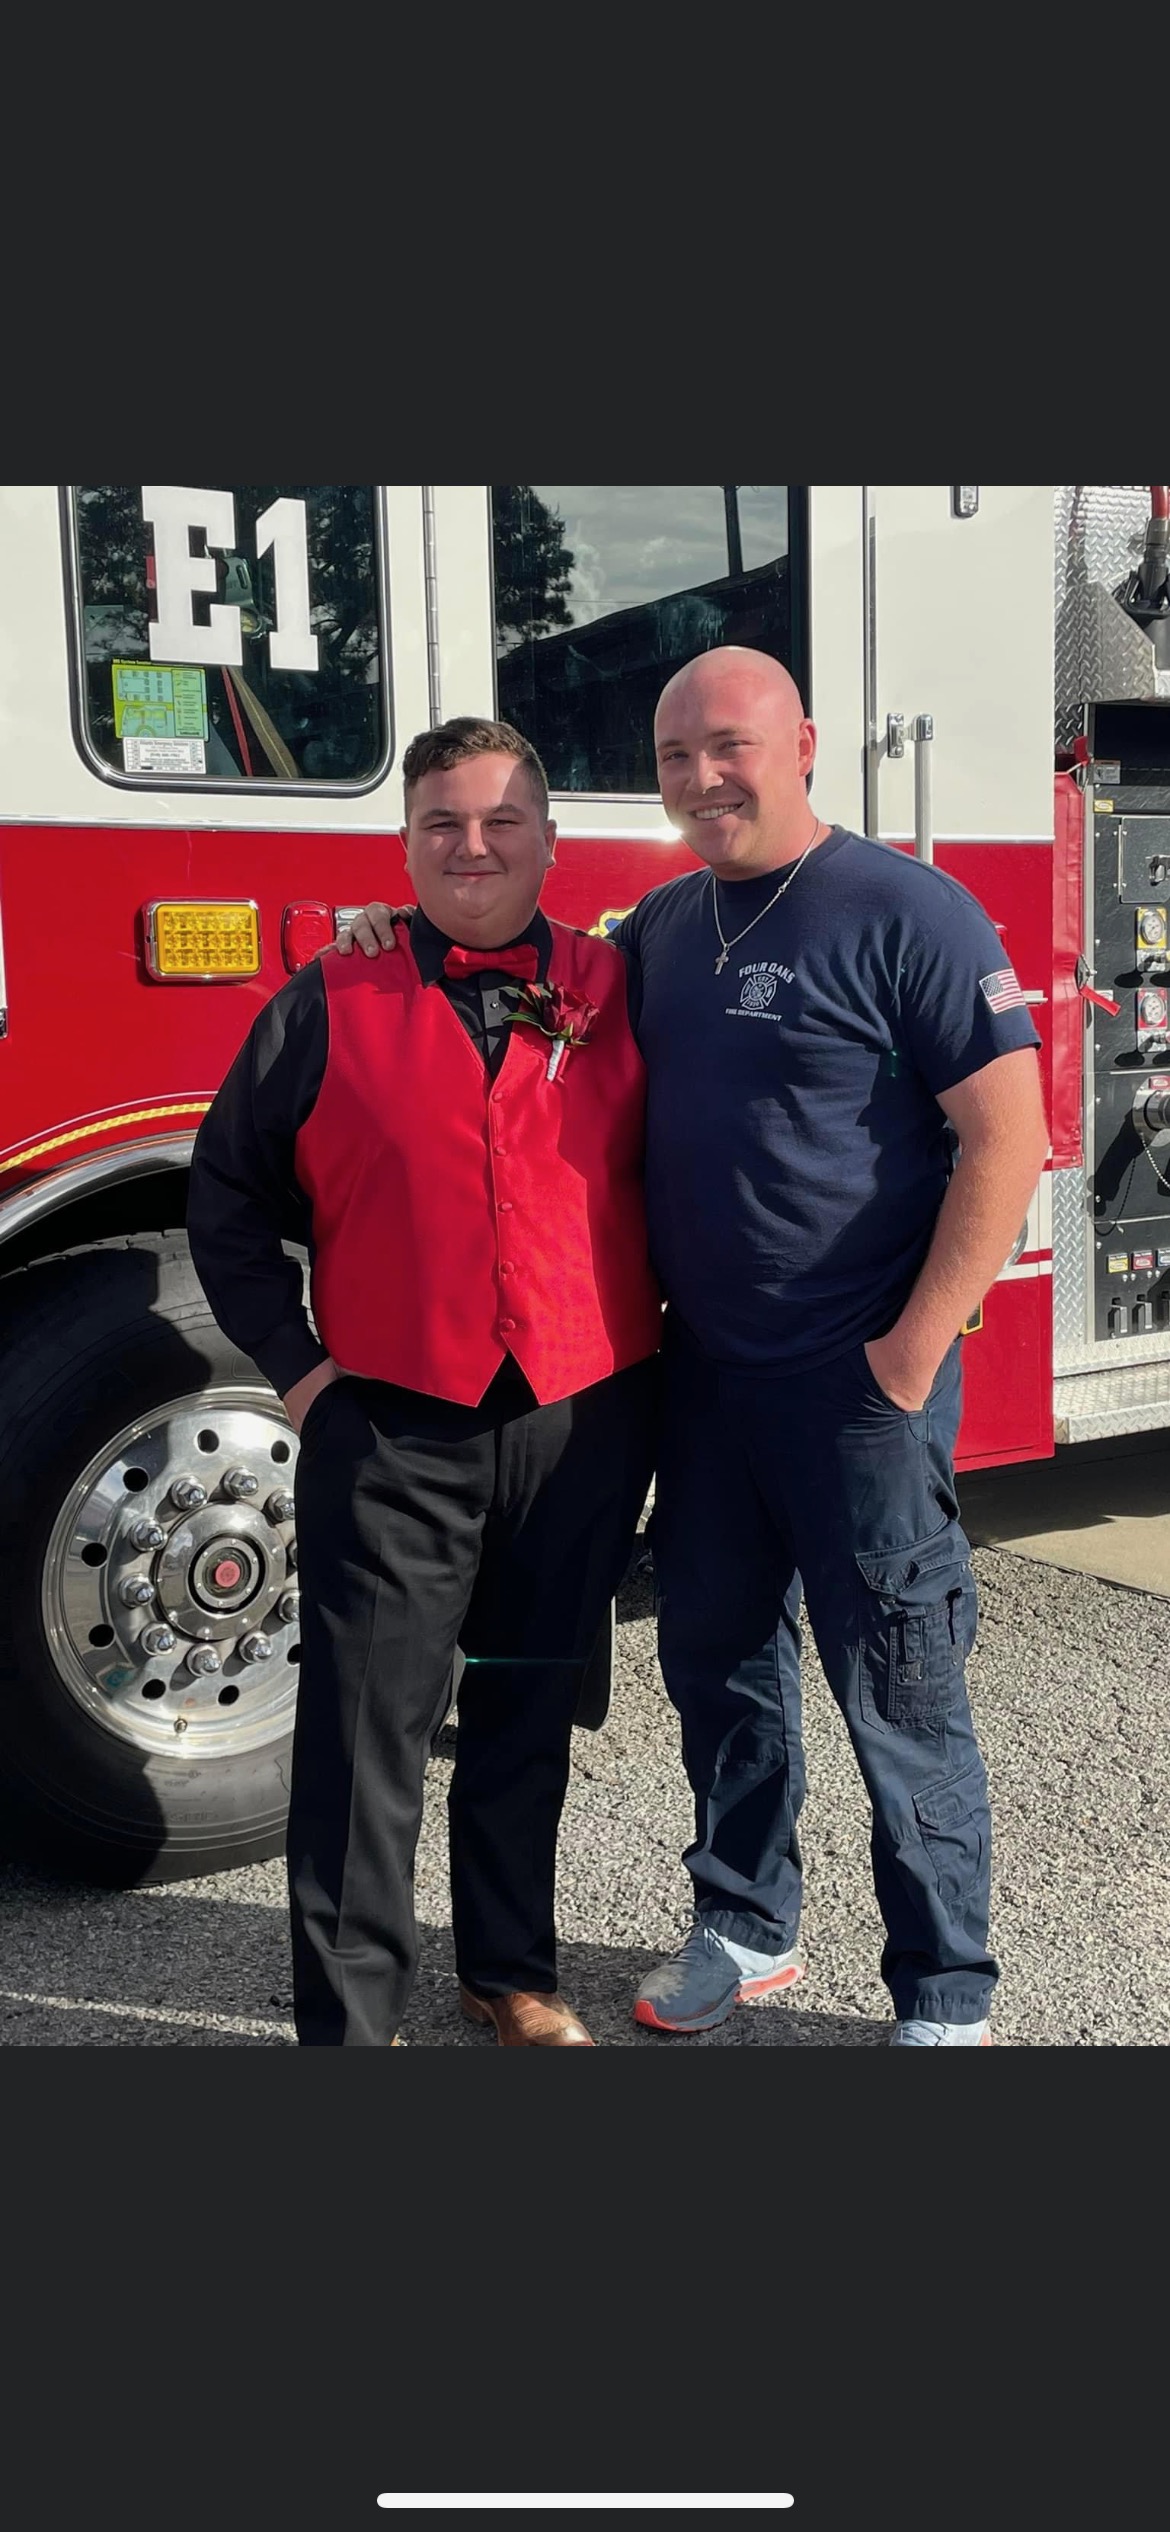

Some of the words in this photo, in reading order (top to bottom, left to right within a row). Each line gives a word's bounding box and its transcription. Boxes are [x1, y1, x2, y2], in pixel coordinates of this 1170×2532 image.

[141, 486, 319, 671] E1
[739, 962, 768, 978] FOUR
[768, 962, 796, 984] OAKS
[738, 1009, 782, 1021] DEPARTMENT
